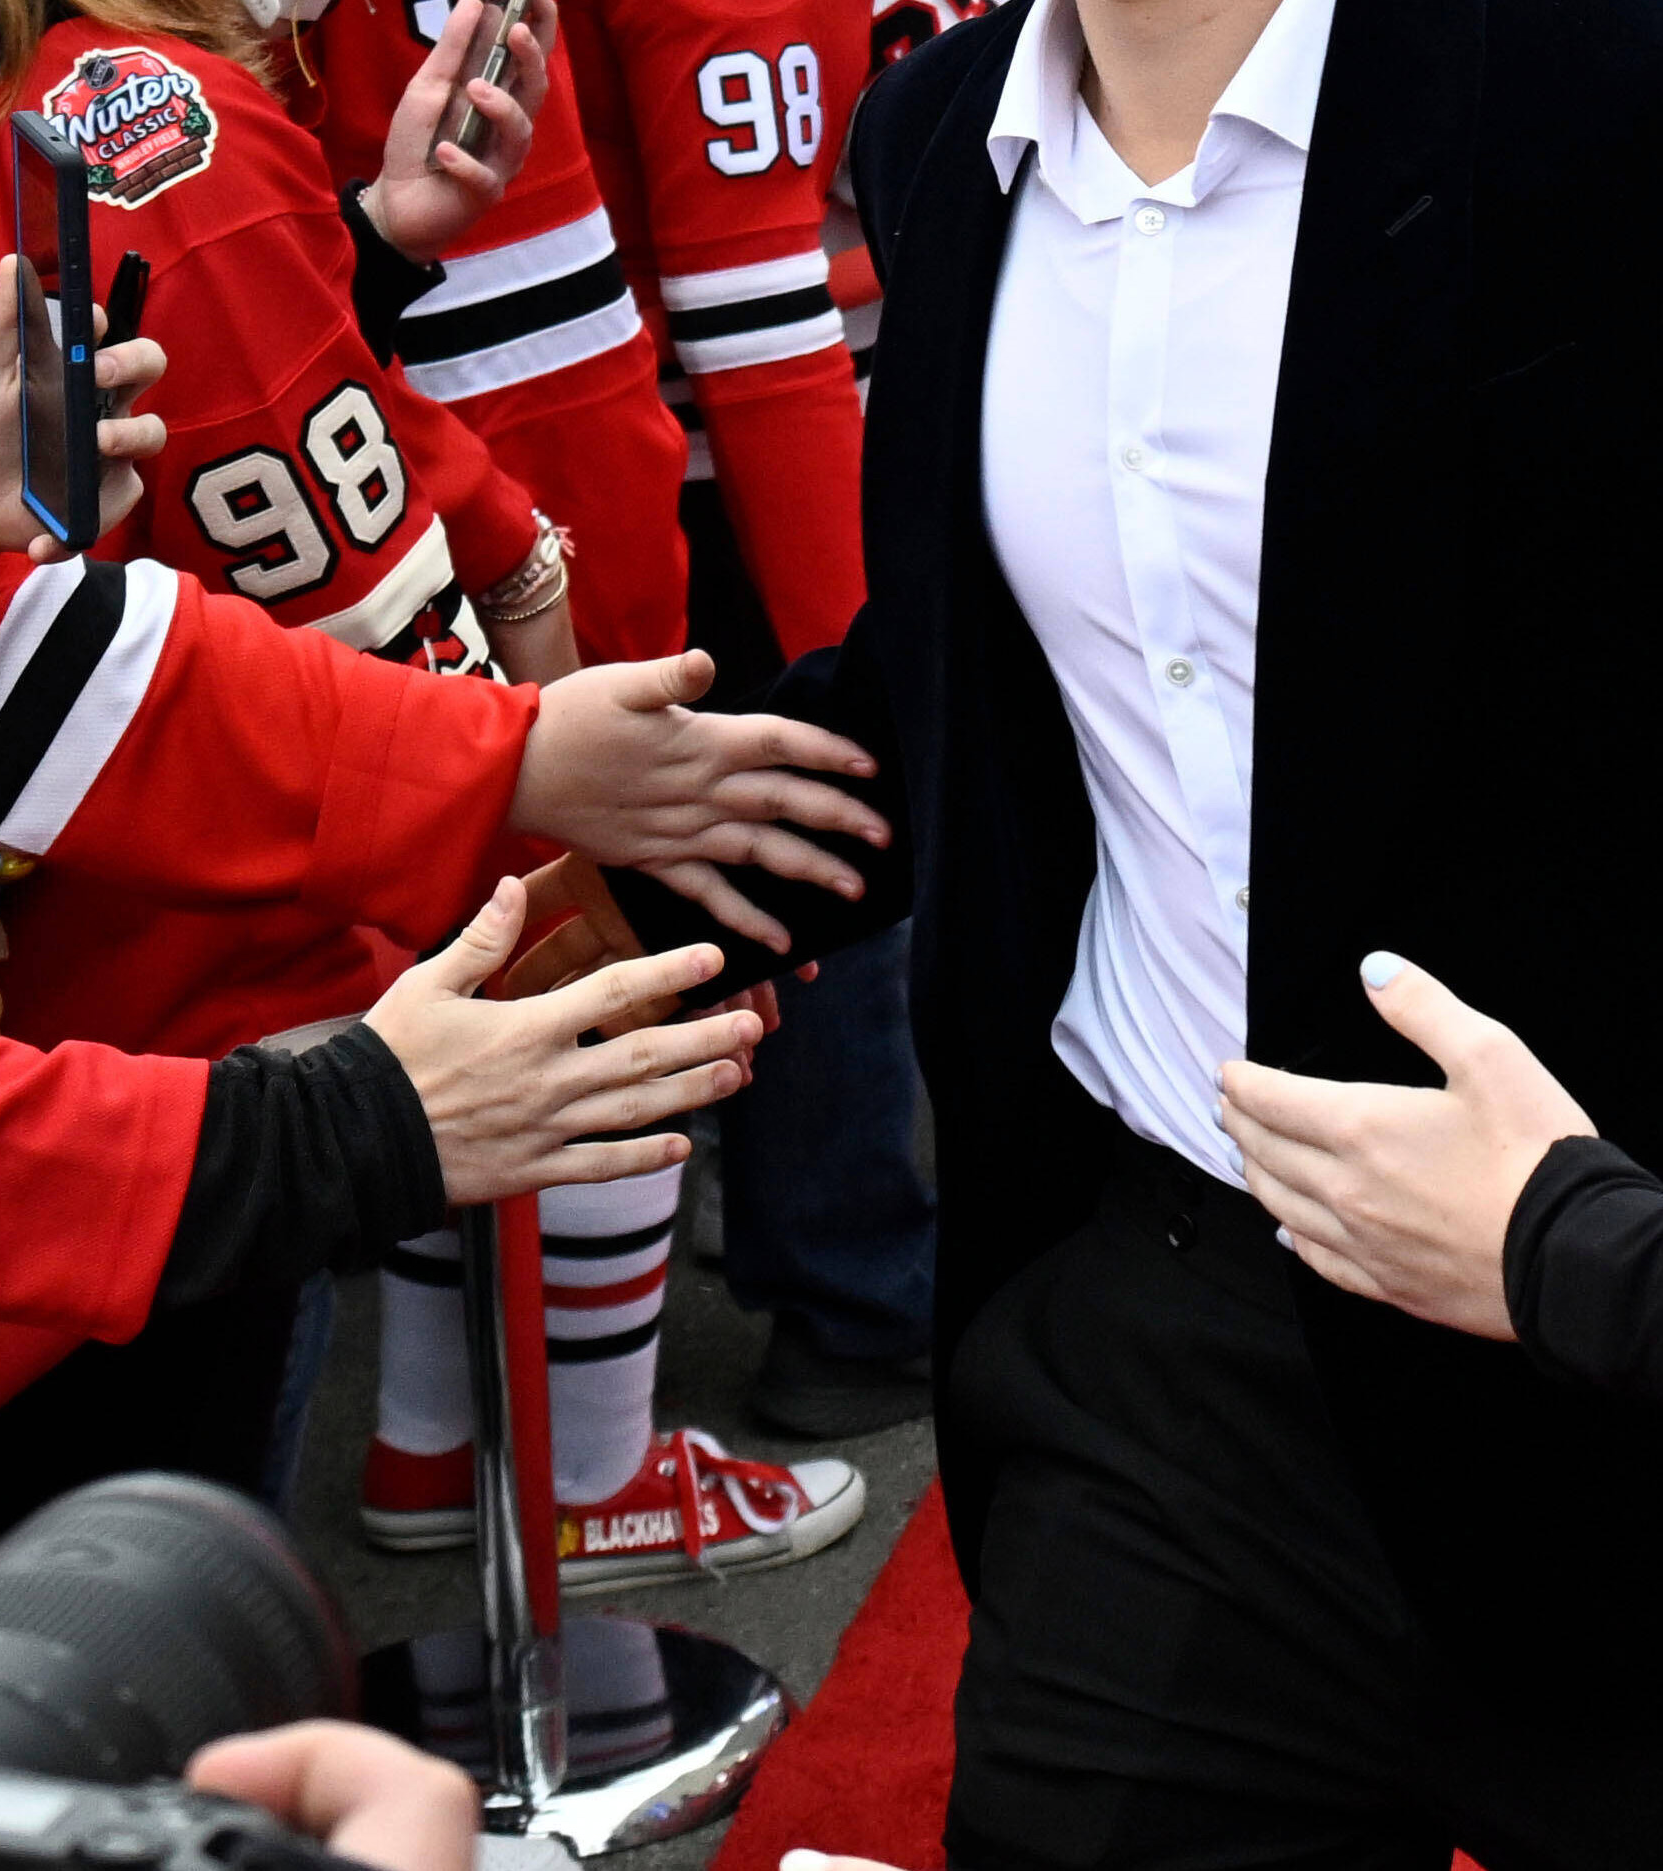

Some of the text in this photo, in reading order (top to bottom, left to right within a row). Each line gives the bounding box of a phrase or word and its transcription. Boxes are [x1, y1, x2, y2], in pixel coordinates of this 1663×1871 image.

[48, 72, 193, 148] Winter
[97, 106, 179, 160] CLASSIC
[696, 41, 824, 176] 98
[184, 378, 410, 604] 98
[584, 1501, 720, 1552] BLACKHAS
